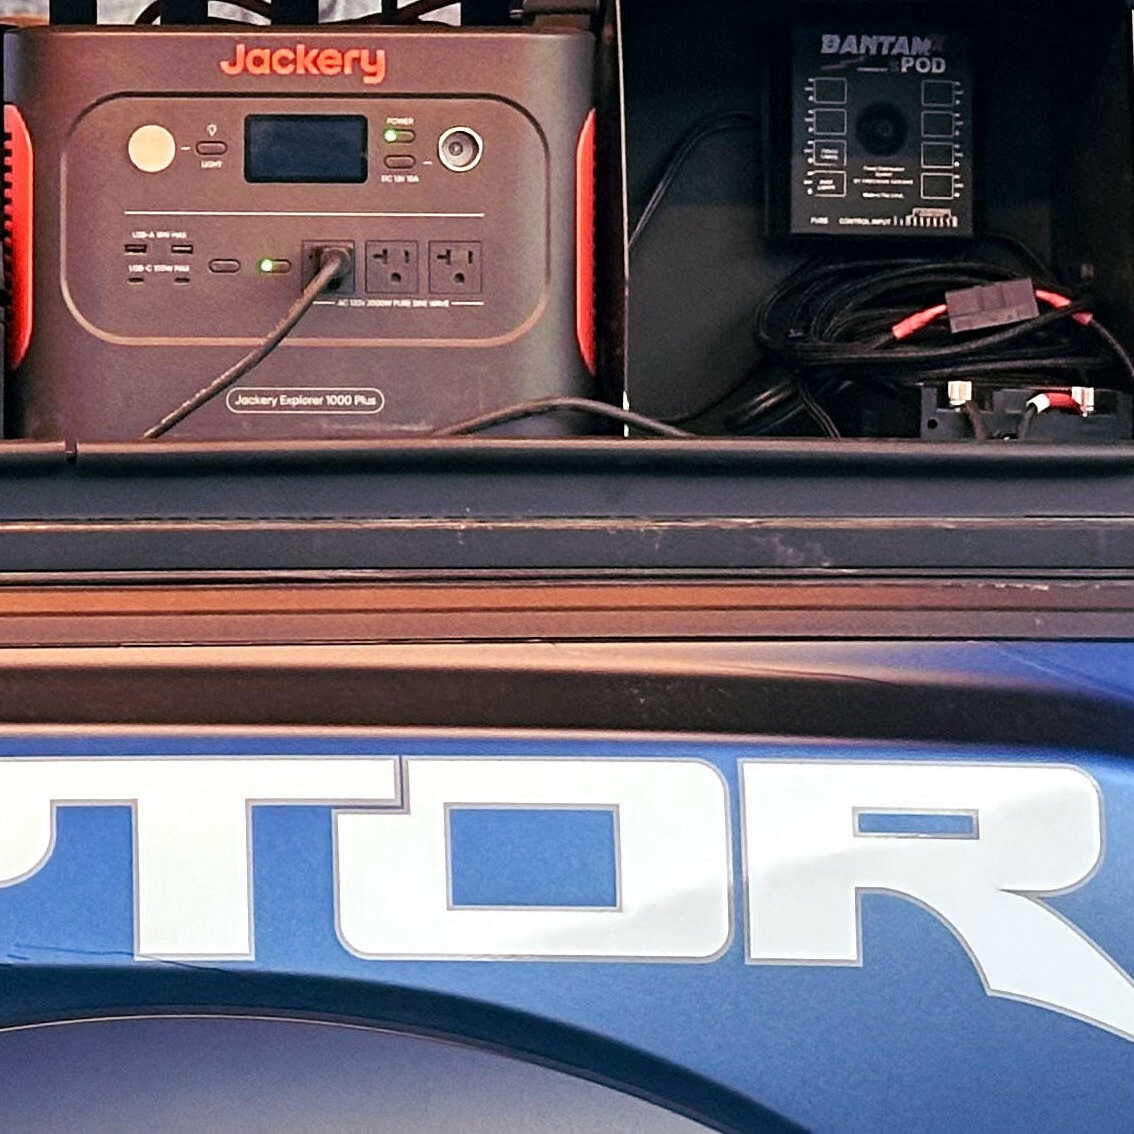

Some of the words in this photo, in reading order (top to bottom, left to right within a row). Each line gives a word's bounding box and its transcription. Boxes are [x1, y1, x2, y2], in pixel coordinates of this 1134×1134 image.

[220, 44, 386, 84] Jackery
[234, 394, 277, 407] Jackery
[279, 394, 324, 407] Explorer
[326, 394, 352, 406] 1000
[354, 394, 377, 406] Plus
